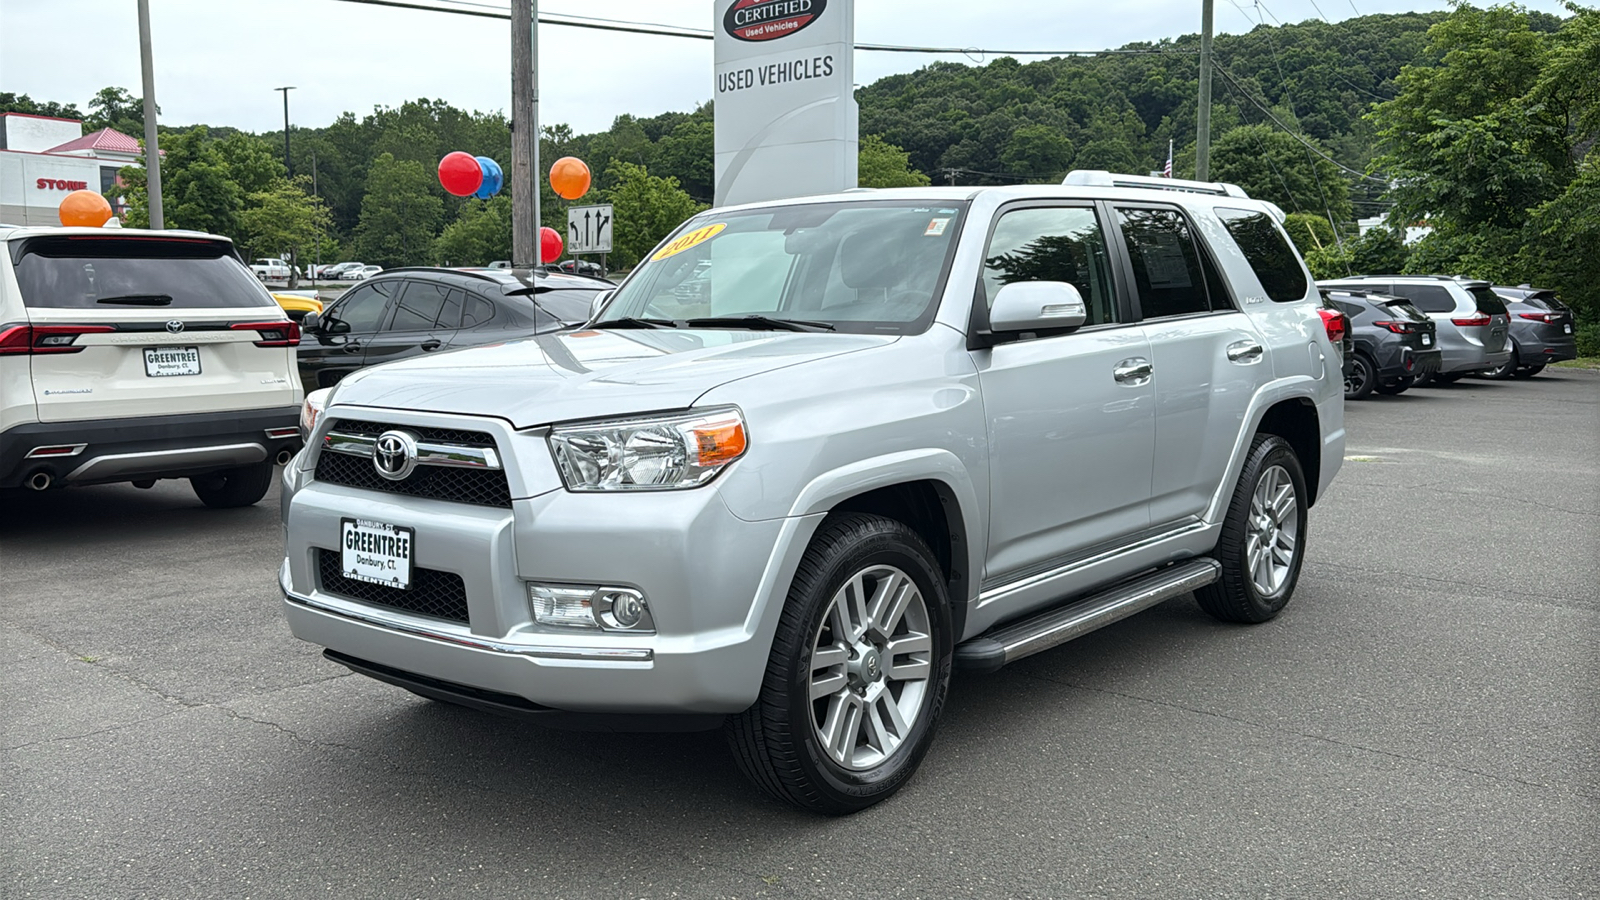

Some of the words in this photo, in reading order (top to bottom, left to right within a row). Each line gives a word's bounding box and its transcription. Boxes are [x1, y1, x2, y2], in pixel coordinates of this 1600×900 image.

[734, 0, 812, 25] CERTIFIED
[745, 26, 764, 37] Used
[764, 20, 799, 34] Vehicles
[718, 68, 754, 93] USED
[758, 55, 834, 86] VEHICLES
[36, 178, 88, 191] STONE
[569, 242, 582, 250] ONLY
[660, 226, 716, 258] 2011
[148, 352, 196, 364] GREENTREE
[346, 530, 408, 559] GREENTREE
[357, 554, 386, 571] Danbury,
[342, 571, 406, 589] GREENTREE
